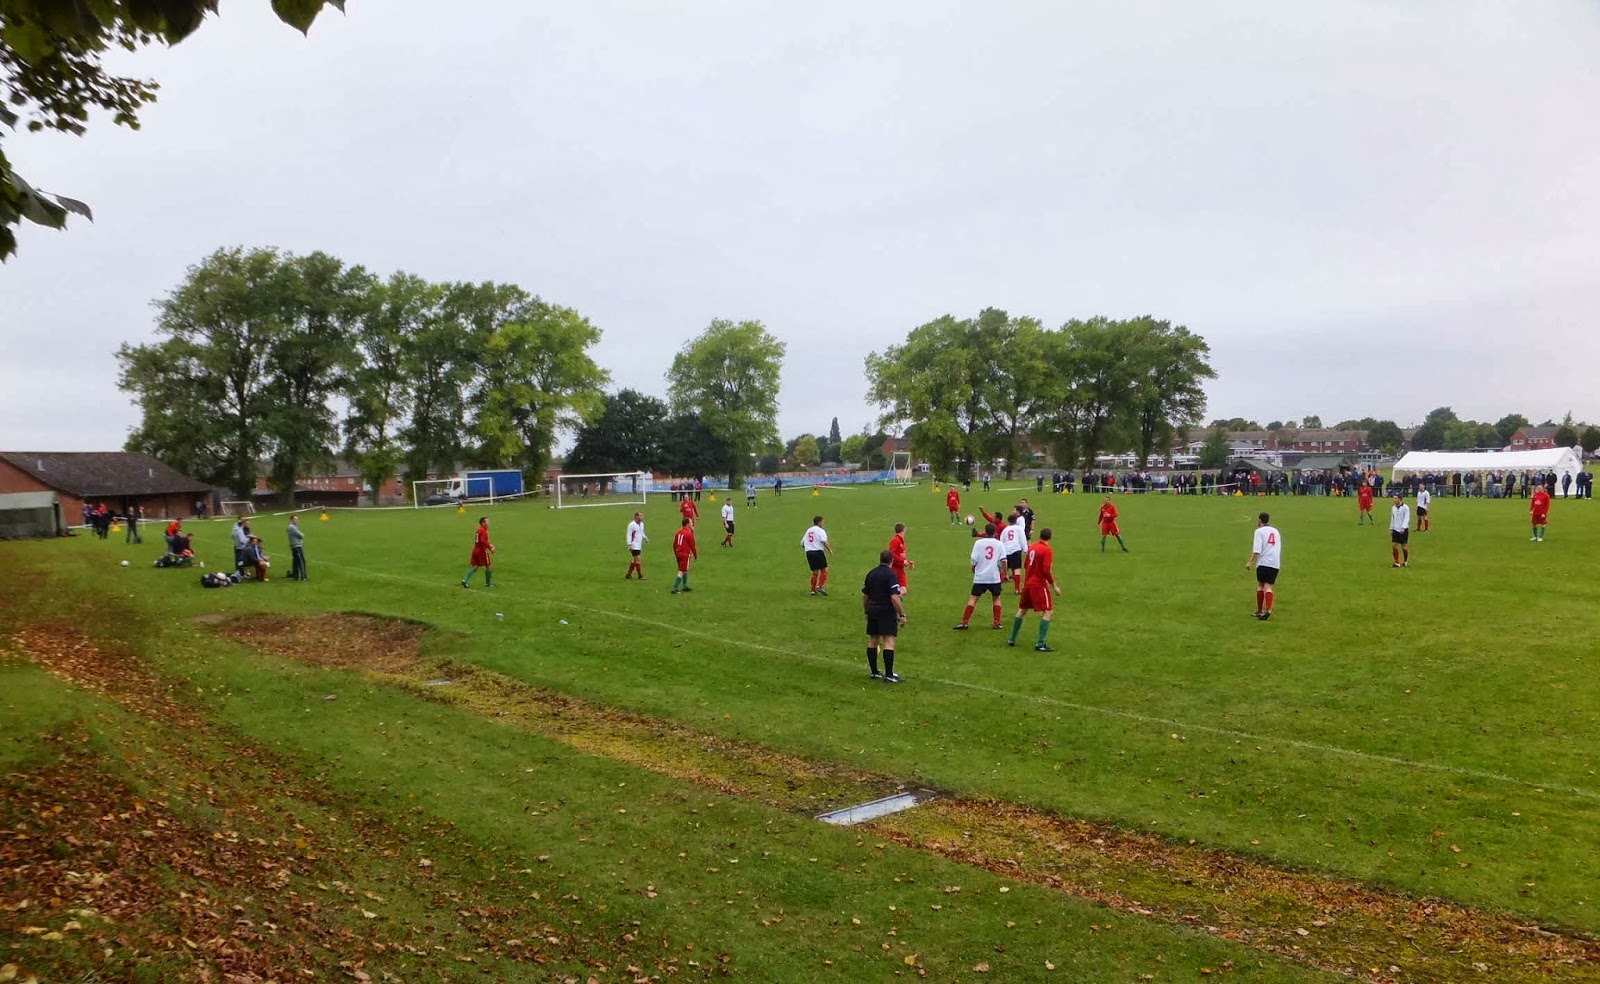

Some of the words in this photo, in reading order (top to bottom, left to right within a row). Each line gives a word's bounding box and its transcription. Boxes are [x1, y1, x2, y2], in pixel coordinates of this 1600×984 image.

[677, 534, 684, 545] 11
[808, 532, 815, 543] 5
[1007, 530, 1014, 540] 6
[1268, 533, 1276, 545] 4
[985, 546, 994, 560] 3
[1029, 550, 1035, 566] 9
